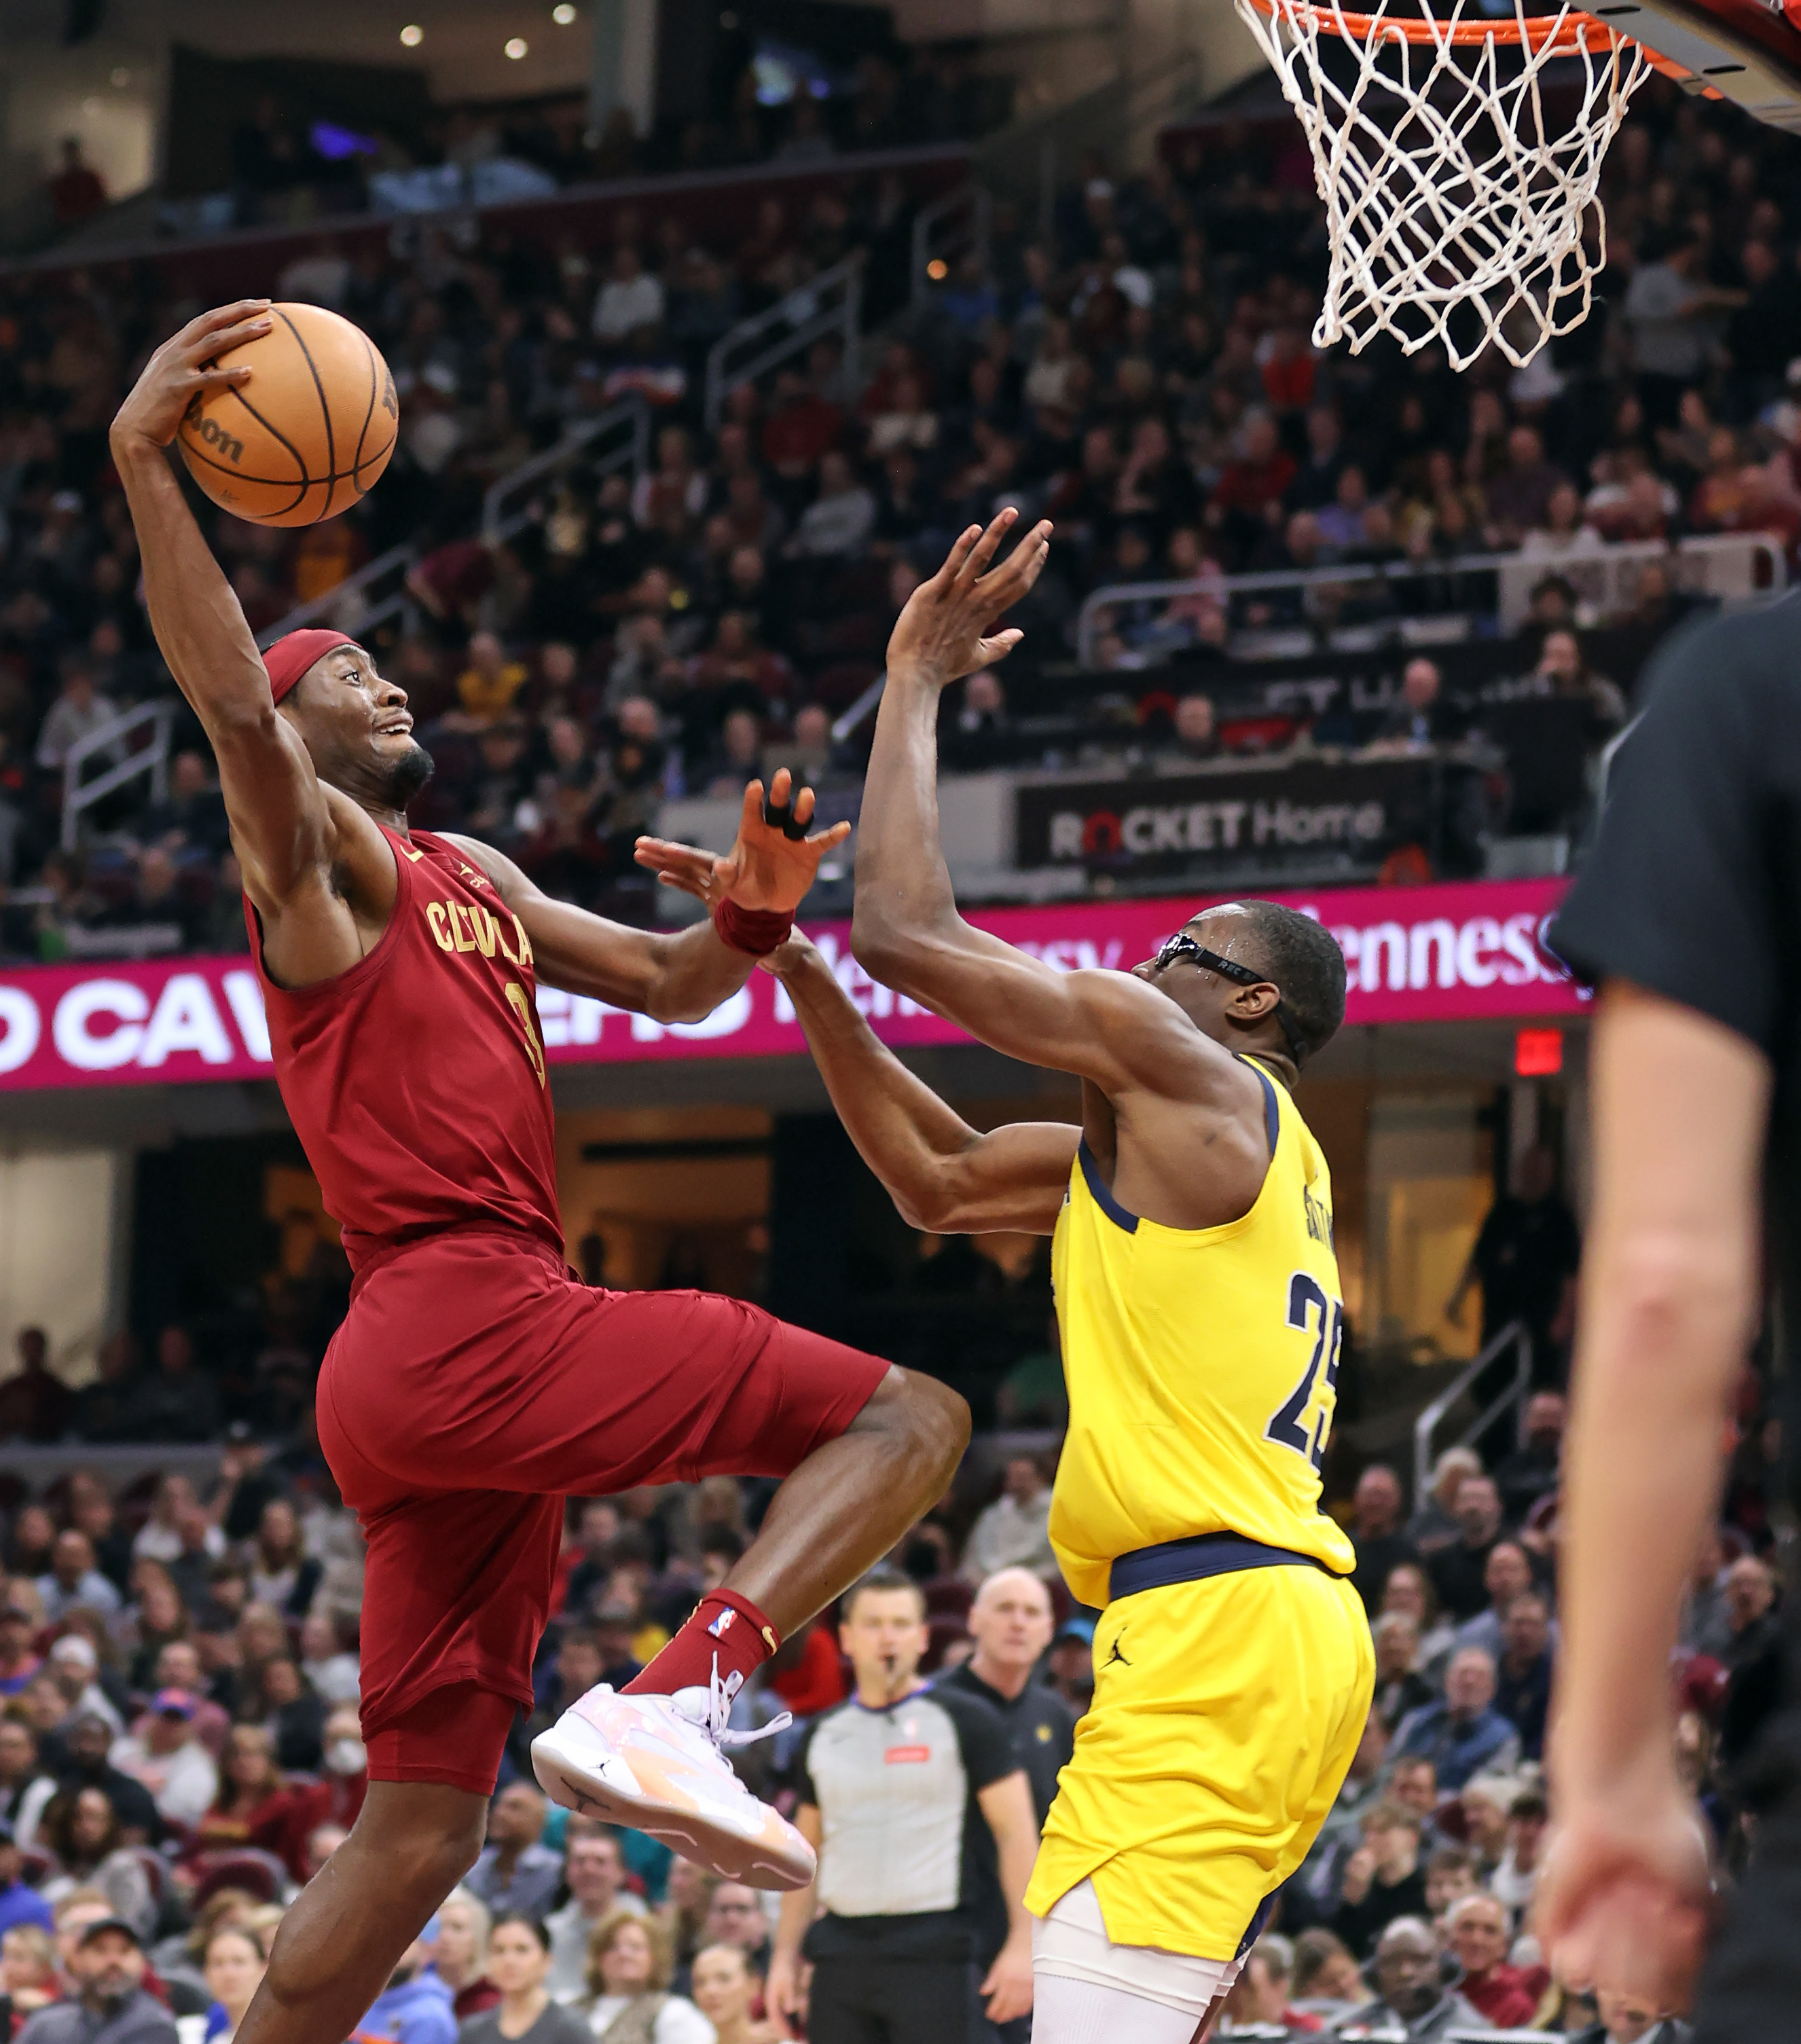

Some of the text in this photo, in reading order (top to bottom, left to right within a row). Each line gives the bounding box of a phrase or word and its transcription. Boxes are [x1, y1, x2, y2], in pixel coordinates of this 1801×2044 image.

[1049, 797, 1385, 857] ROCKET Home
[505, 983, 546, 1091] 3
